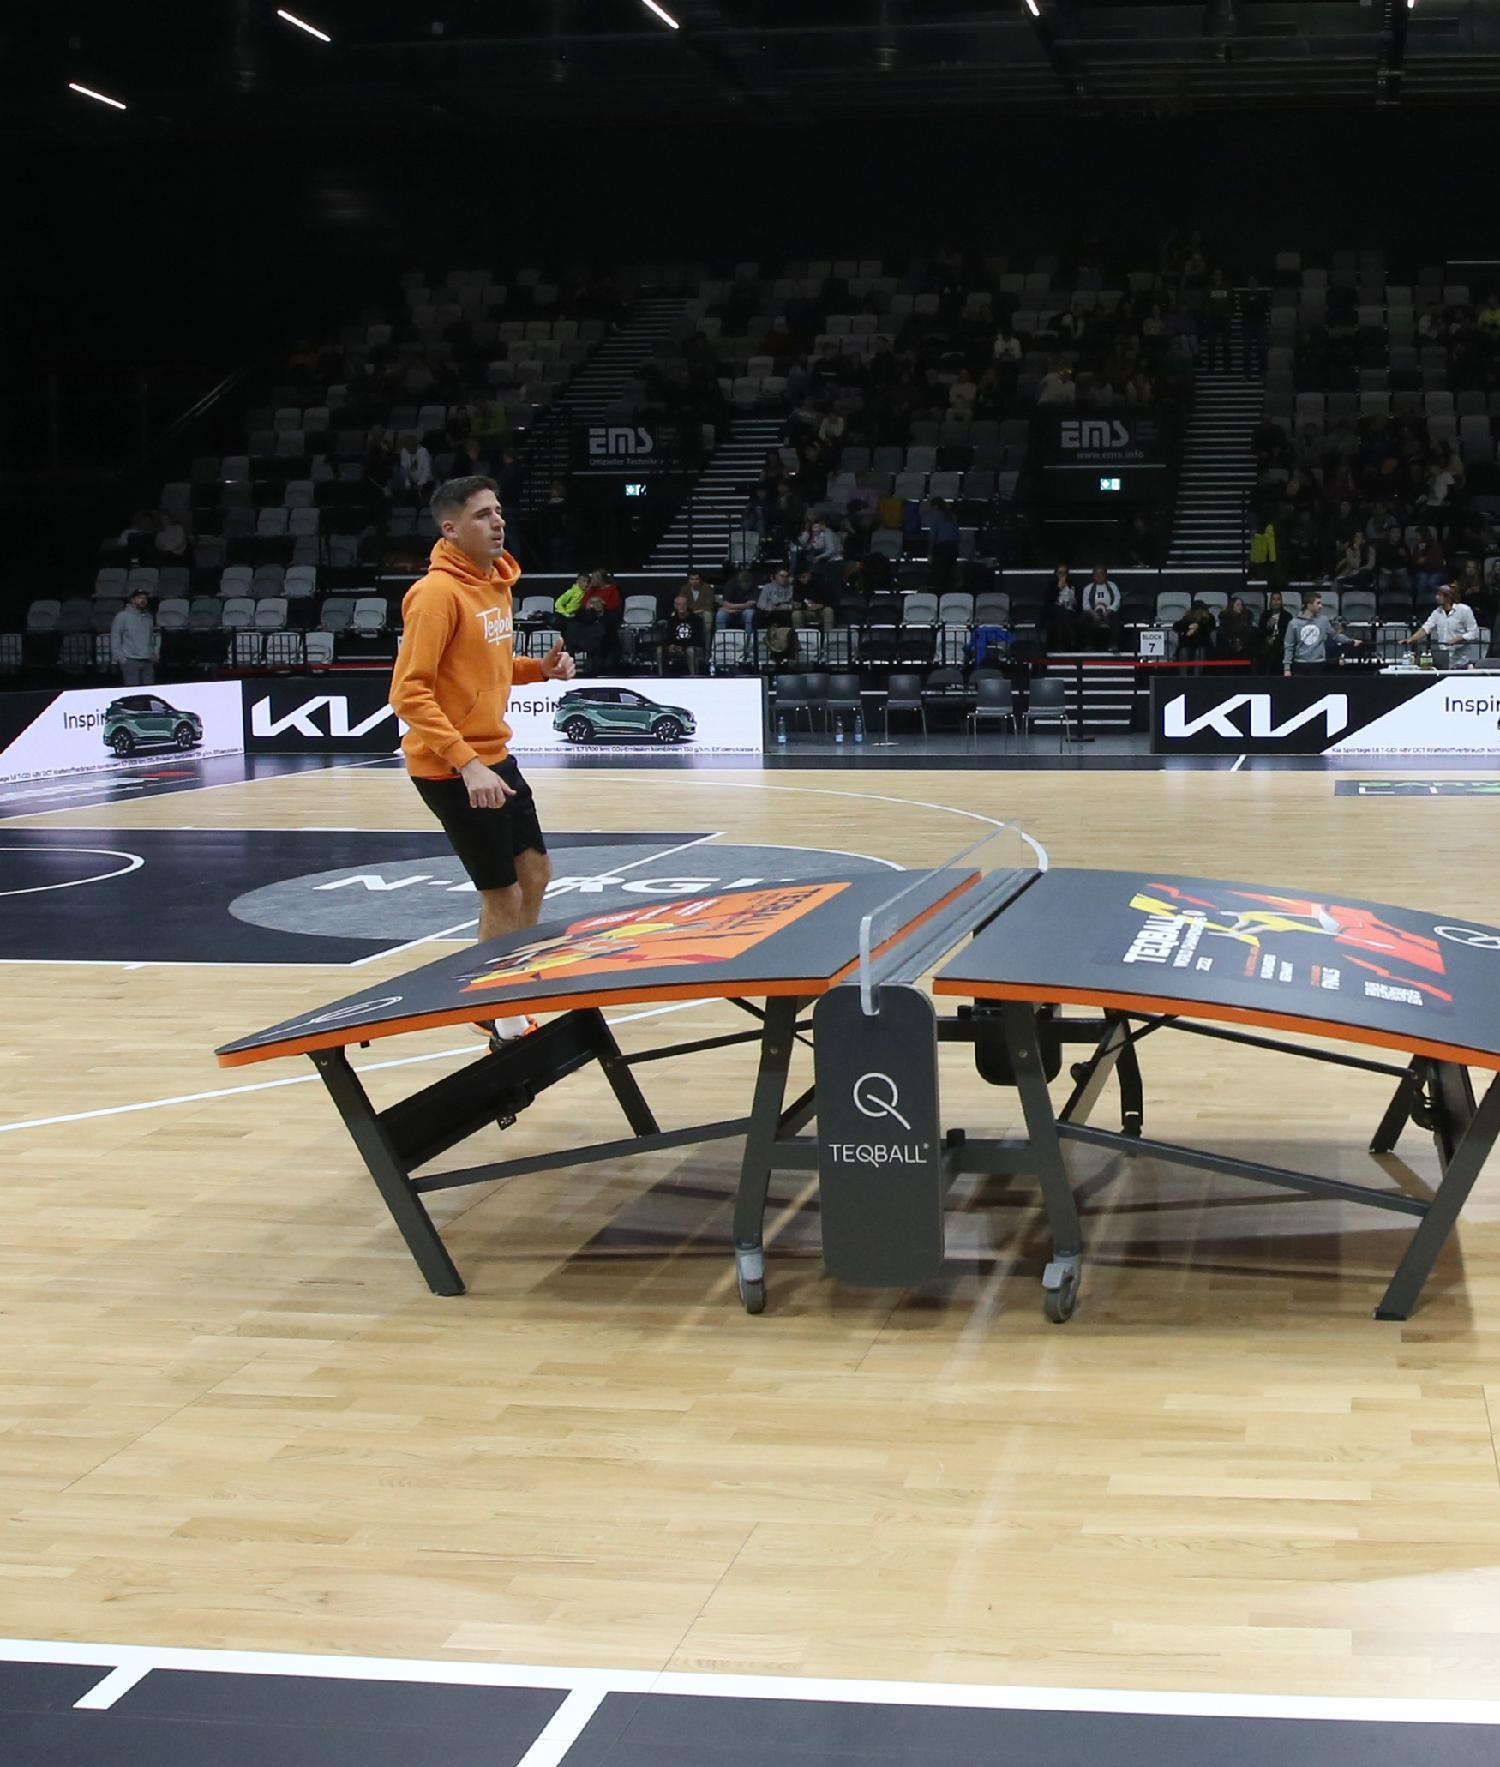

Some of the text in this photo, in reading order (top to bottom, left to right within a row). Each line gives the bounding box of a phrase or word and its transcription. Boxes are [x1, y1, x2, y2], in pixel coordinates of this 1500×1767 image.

[589, 427, 653, 454] EMS
[1061, 420, 1129, 448] EMS
[1149, 642, 1156, 653] 7
[1123, 914, 1186, 963] TEQBALL
[828, 1143, 928, 1168] TEQBALL
